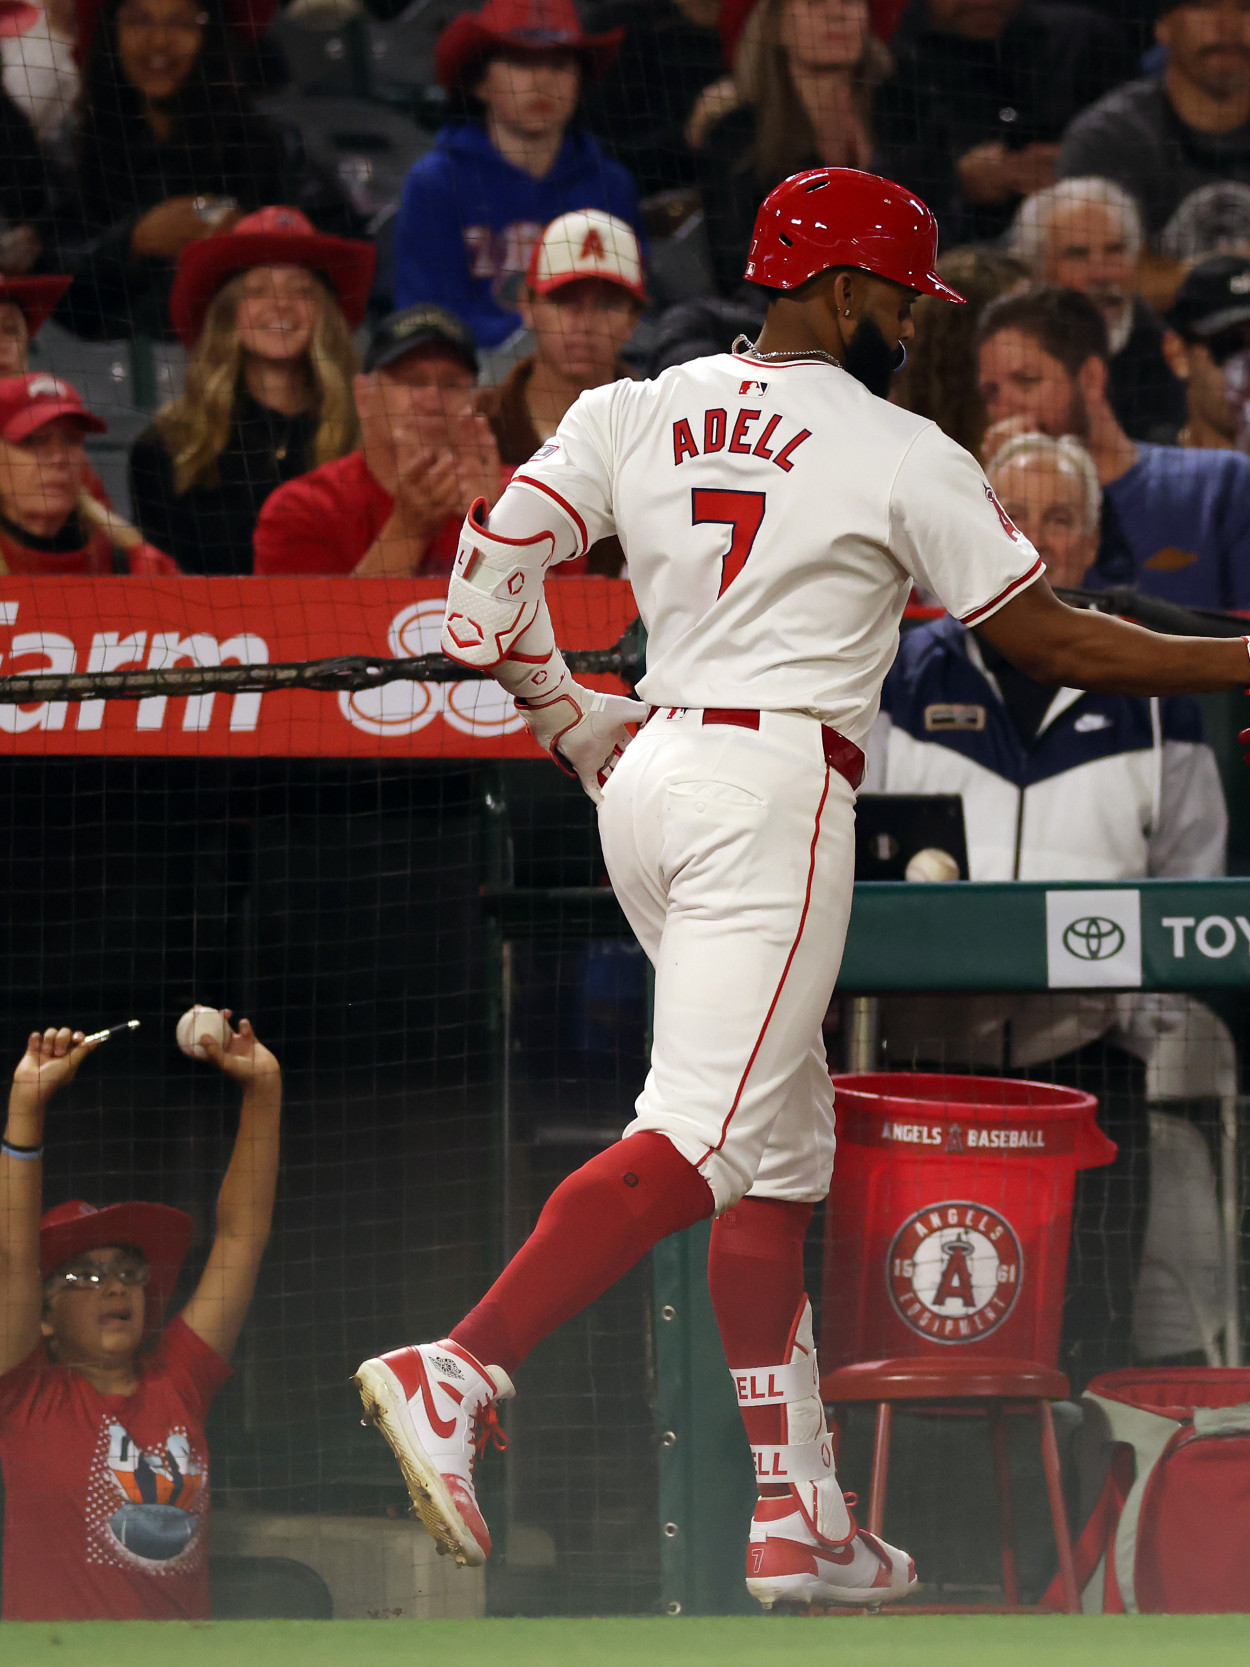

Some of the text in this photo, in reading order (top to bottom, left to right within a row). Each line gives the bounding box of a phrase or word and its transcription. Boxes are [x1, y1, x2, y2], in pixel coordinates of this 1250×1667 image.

[580, 228, 605, 260] A
[673, 408, 812, 472] ADELL
[691, 487, 767, 602] 7
[0, 601, 269, 733] arm
[881, 1123, 943, 1145] ANGELS
[967, 1129, 1045, 1148] BASEBALL
[914, 1208, 1005, 1240] ANGELS
[931, 1232, 977, 1308] A
[736, 1373, 784, 1400] ELL
[751, 1548, 764, 1573] 7
